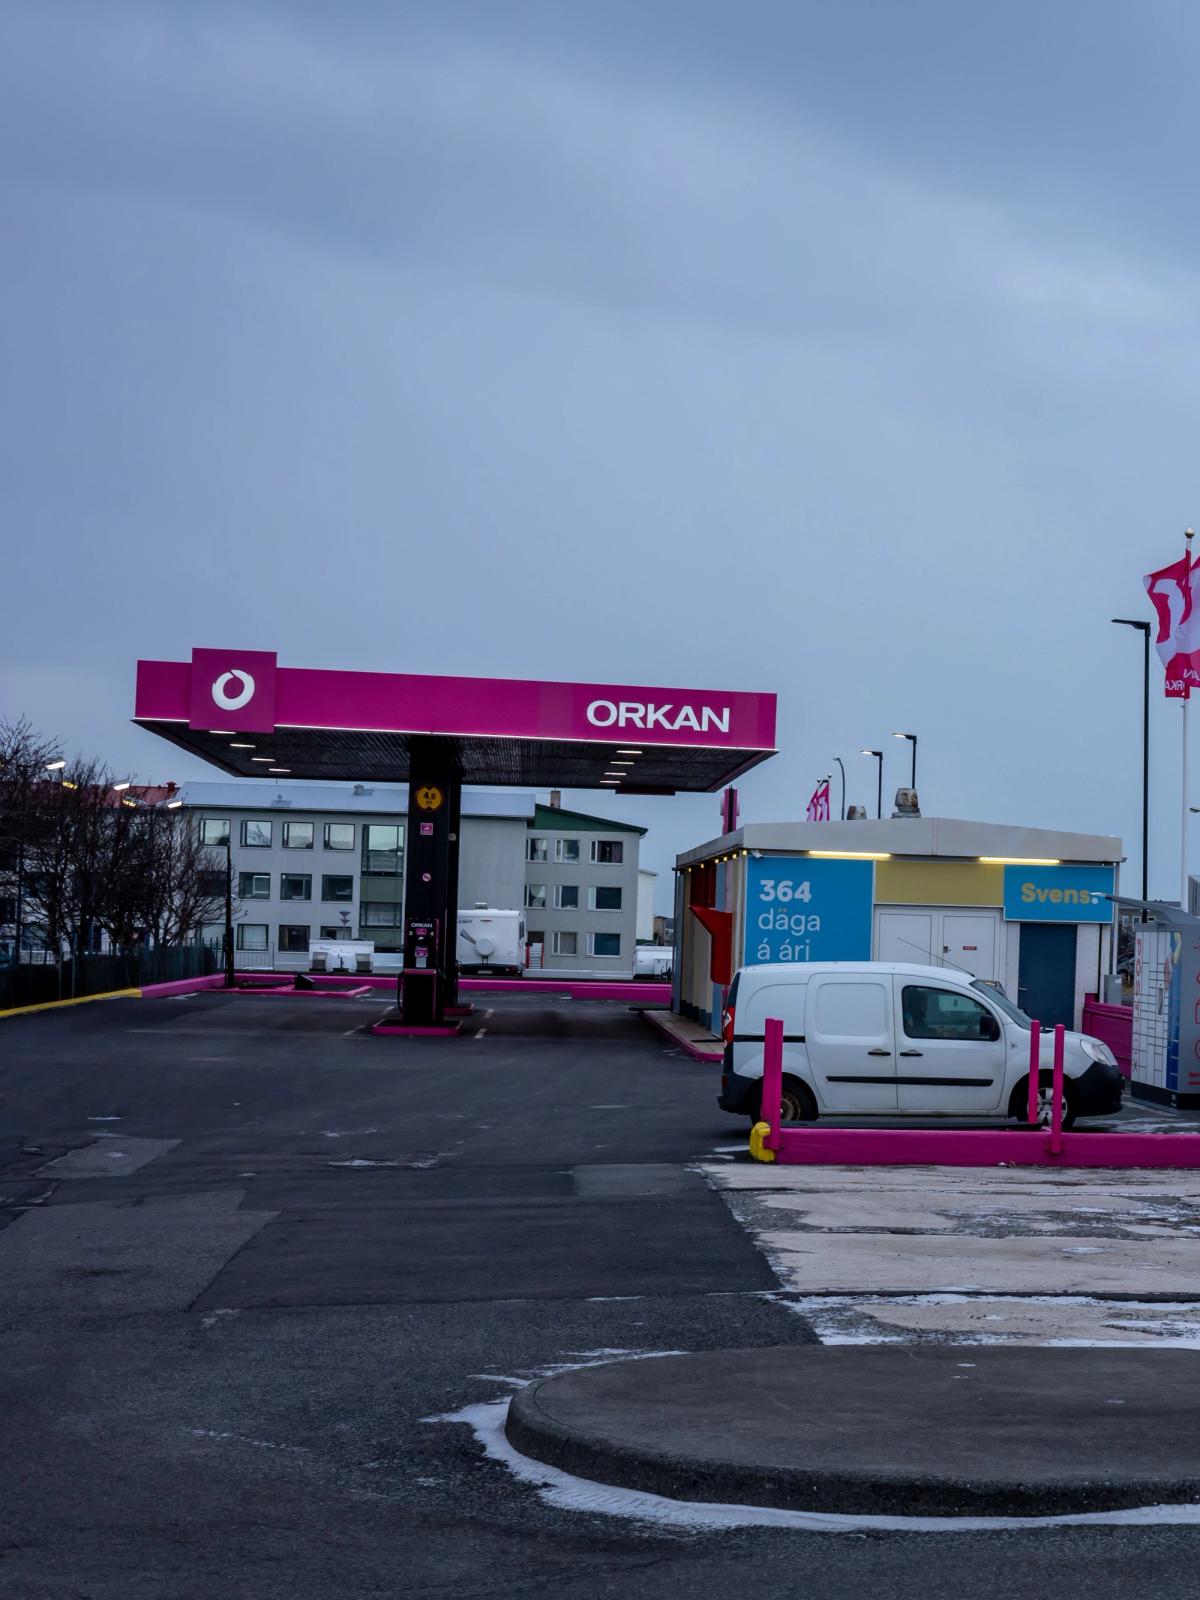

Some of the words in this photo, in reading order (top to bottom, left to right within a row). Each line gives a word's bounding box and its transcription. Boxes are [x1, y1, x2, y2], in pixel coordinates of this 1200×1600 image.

[586, 699, 731, 733] ORKAN
[759, 879, 812, 902] 364
[1021, 882, 1099, 905] Svens.
[757, 938, 771, 960] á
[778, 938, 811, 961] ári
